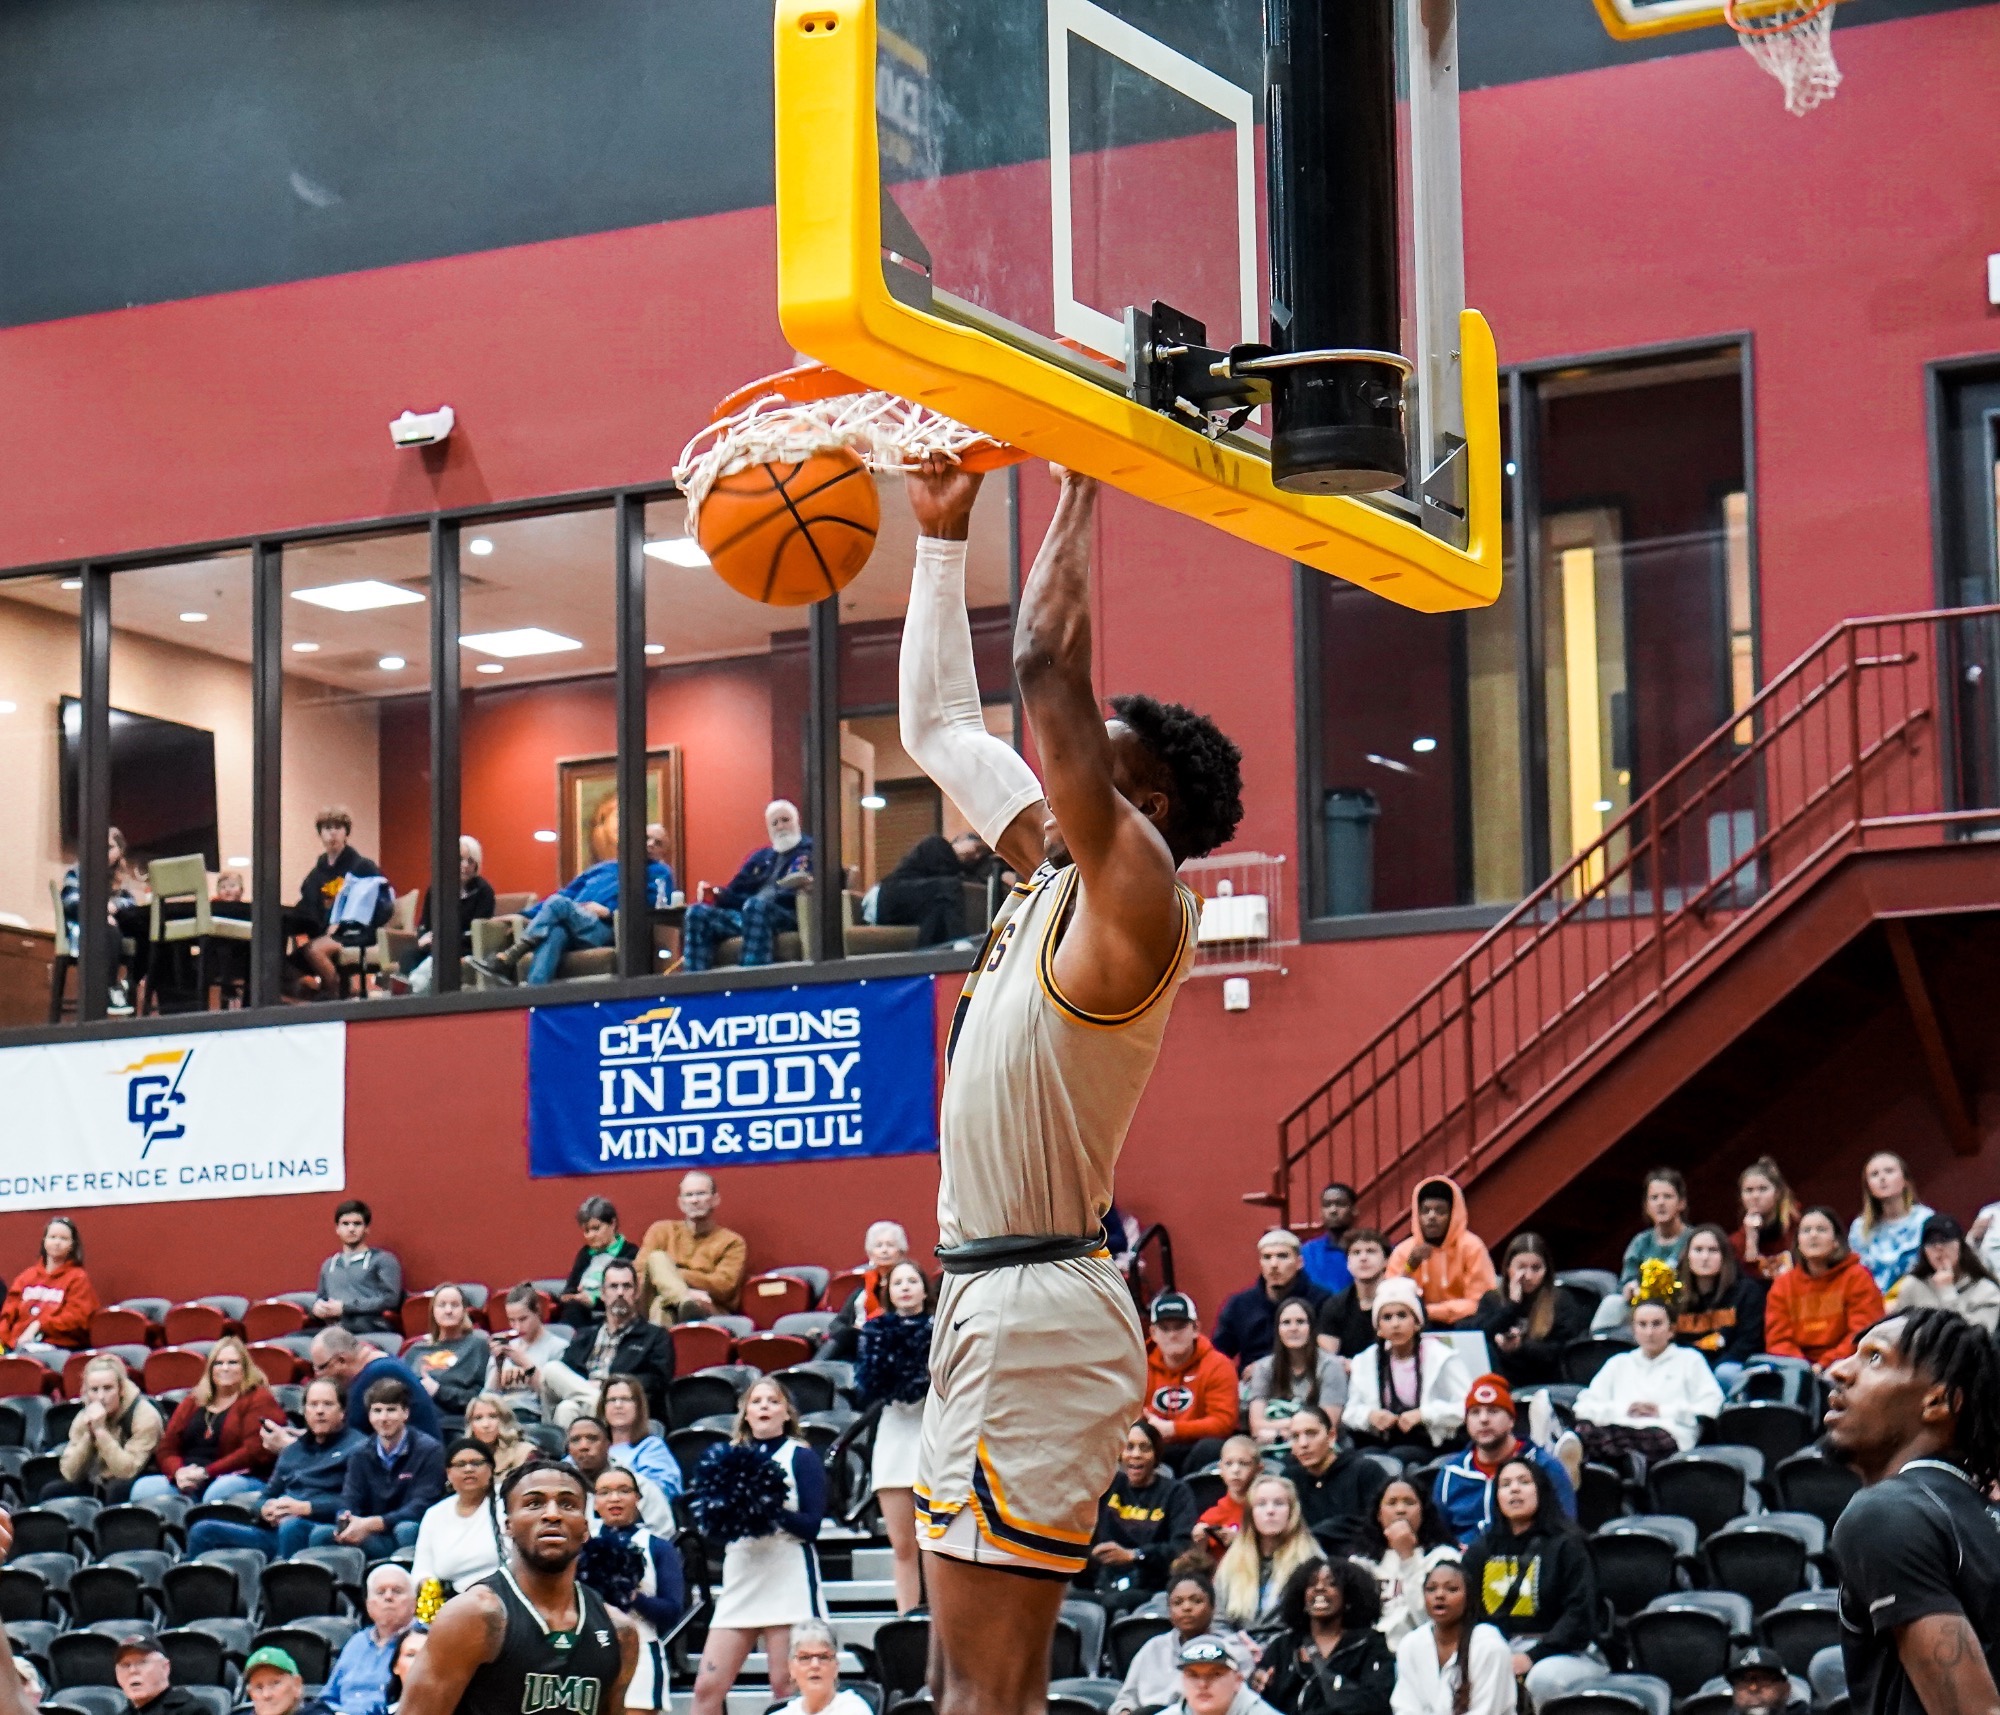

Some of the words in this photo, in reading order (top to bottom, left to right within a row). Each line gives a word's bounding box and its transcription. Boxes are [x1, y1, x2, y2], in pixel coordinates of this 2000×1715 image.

[599, 1007, 861, 1056] CHAMPIONS
[600, 1066, 664, 1115] IN
[680, 1052, 861, 1110] BODY,
[600, 1125, 705, 1161] MIND
[711, 1123, 743, 1153] &
[747, 1114, 862, 1152] SOUL
[0, 1167, 168, 1196] CONFERENCE
[179, 1158, 329, 1185] CAROLINAS
[521, 1672, 601, 1715] UMO
